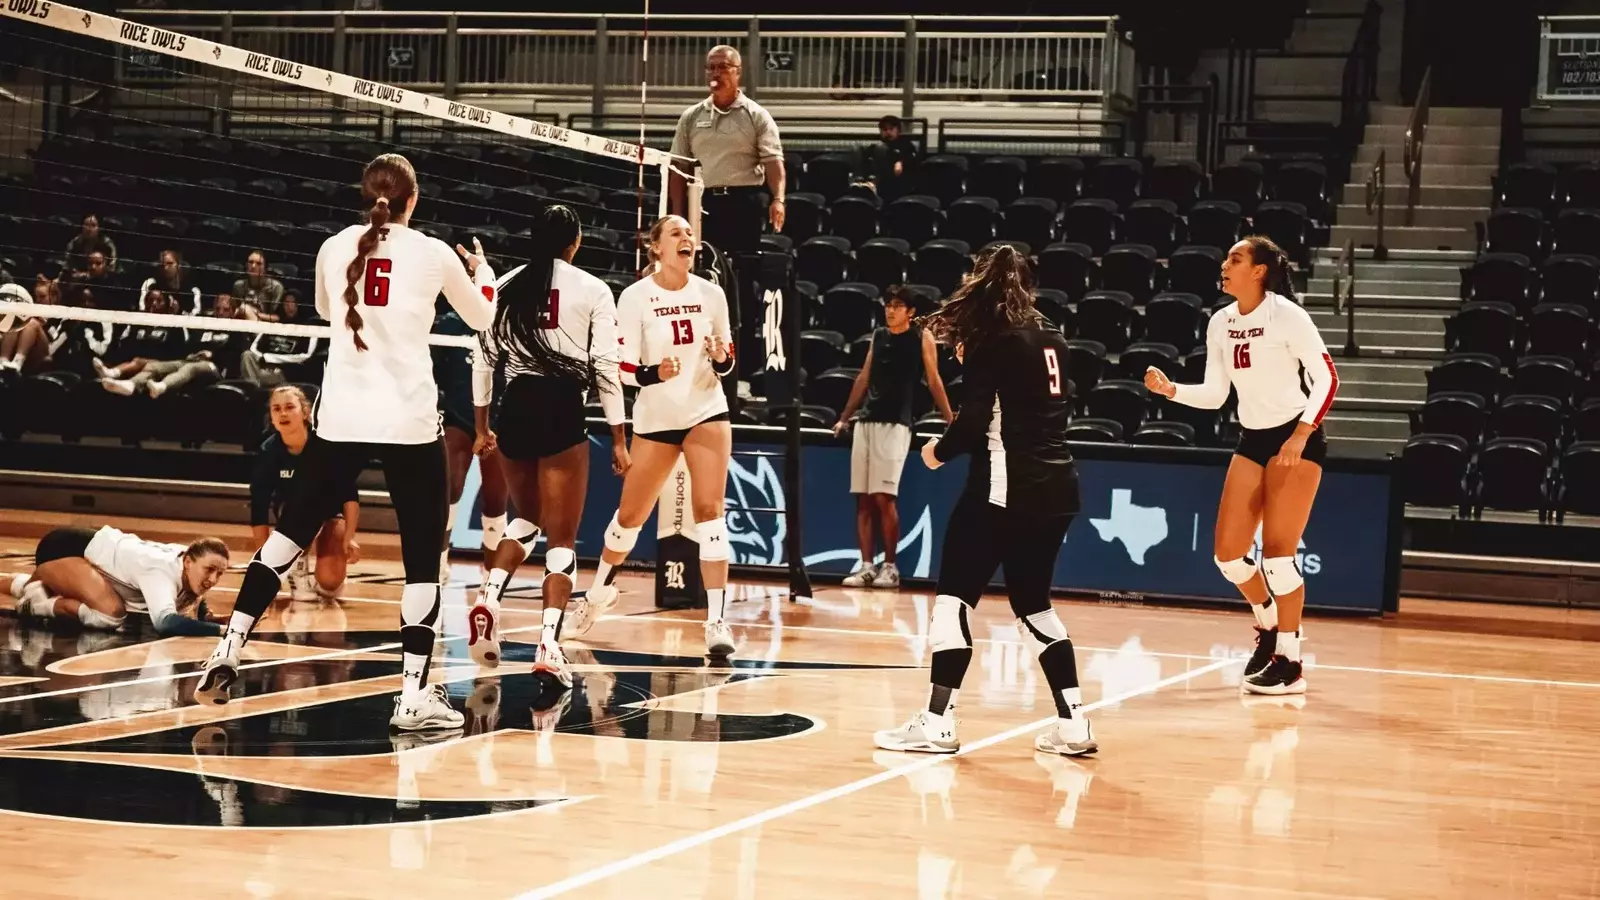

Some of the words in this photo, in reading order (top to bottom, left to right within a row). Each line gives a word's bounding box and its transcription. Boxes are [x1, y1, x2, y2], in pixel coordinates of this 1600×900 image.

[120, 21, 150, 43] RICE
[151, 29, 187, 52] OWLS
[244, 53, 271, 72] RICE
[271, 60, 303, 80] OWLS
[353, 80, 376, 97] RICE
[376, 85, 404, 104] OWLS
[447, 102, 467, 119] RICE
[468, 107, 492, 124] OWLS
[530, 122, 548, 137] RICE
[549, 126, 570, 142] OWLS
[364, 257, 392, 307] 6
[653, 306, 681, 317] TEXAS
[681, 304, 702, 314] TECH
[671, 319, 694, 346] 13
[1247, 327, 1265, 338] TECH
[1233, 342, 1252, 370] 16
[1043, 346, 1062, 398] 9
[675, 470, 686, 507] sports
[664, 560, 686, 589] R
